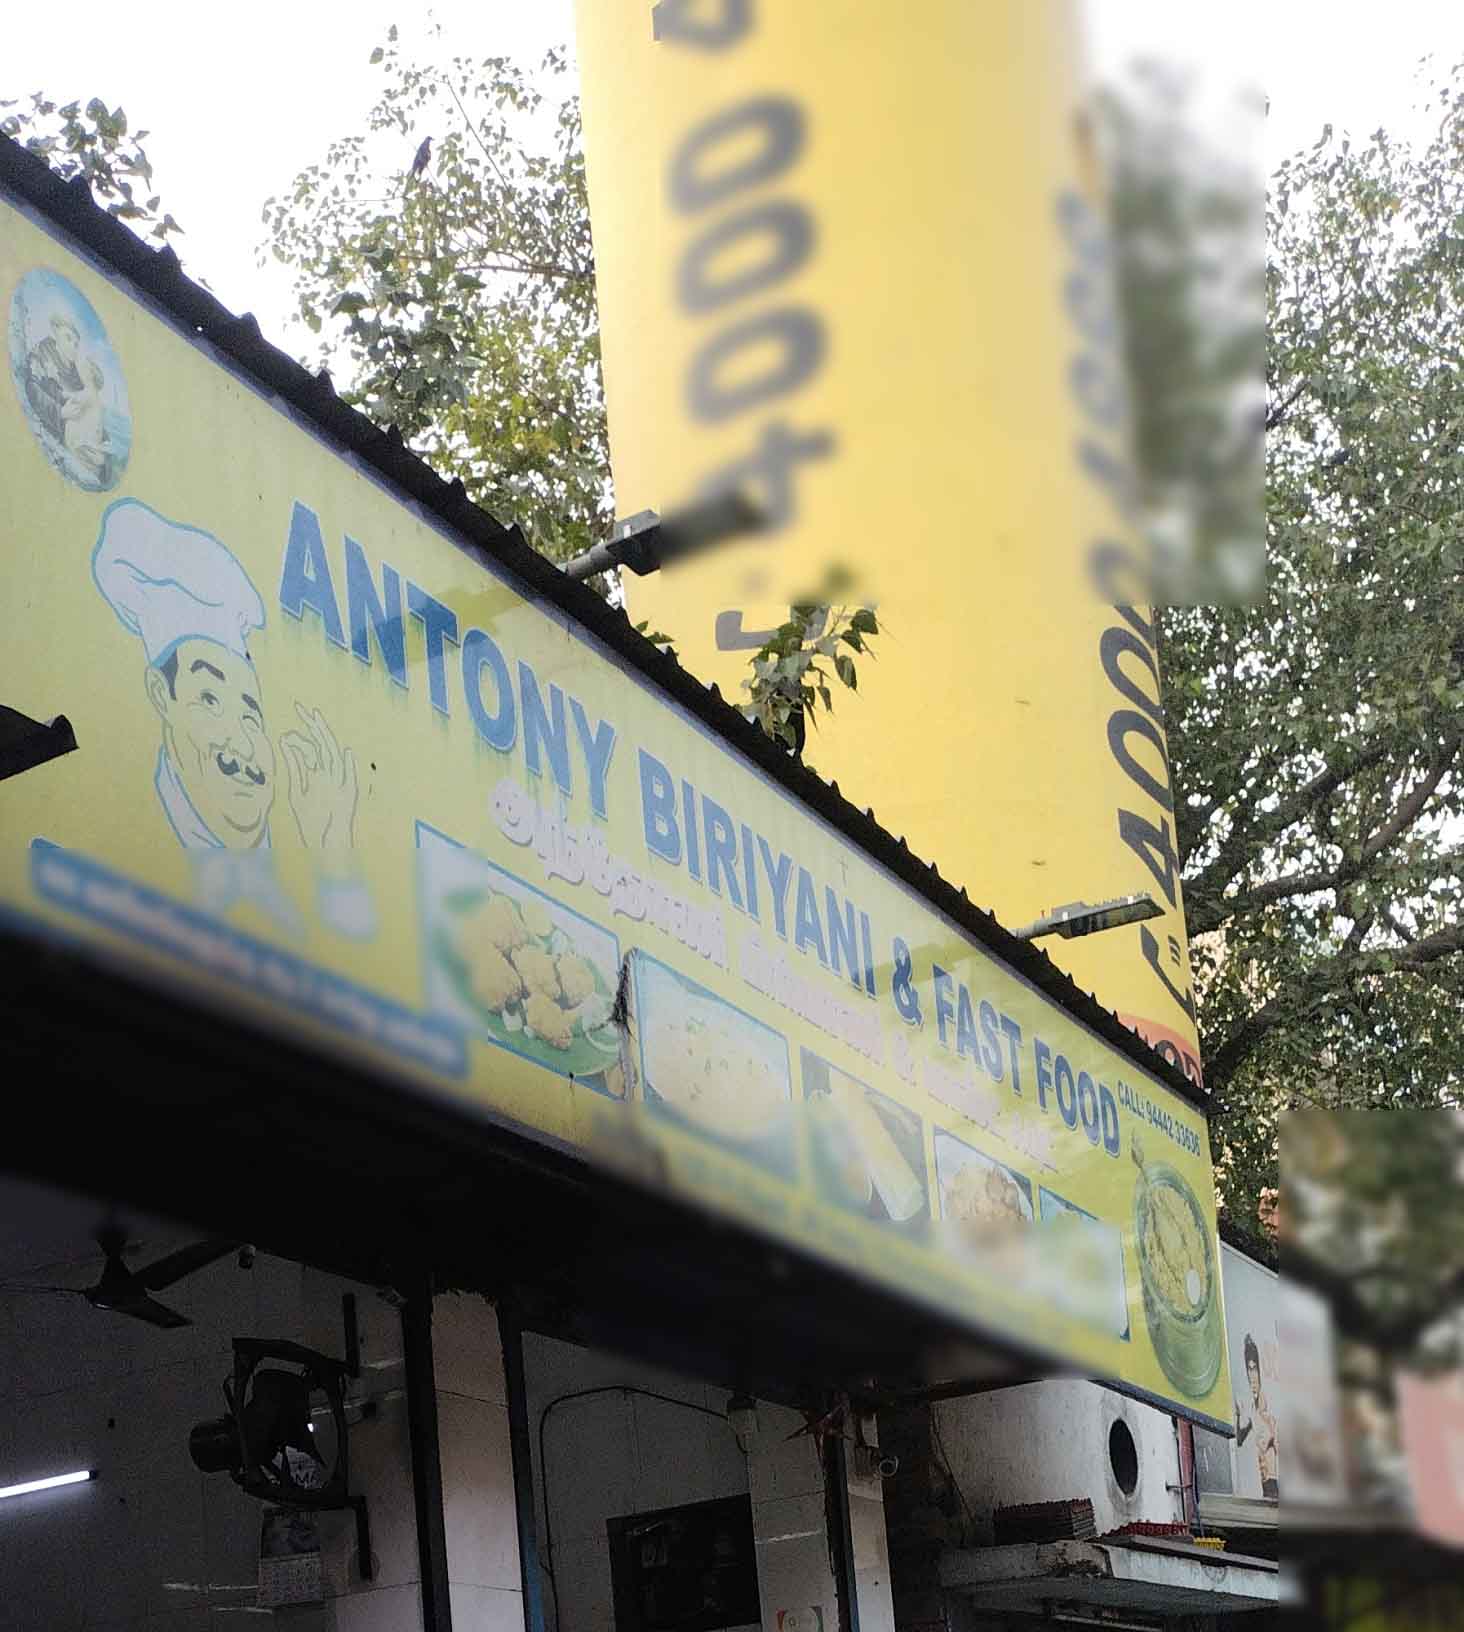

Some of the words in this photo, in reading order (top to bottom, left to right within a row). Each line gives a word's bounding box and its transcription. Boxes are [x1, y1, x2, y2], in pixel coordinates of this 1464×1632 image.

[279, 499, 617, 822] ANTONY
[637, 747, 879, 1000] BIRIYANI
[891, 936, 924, 1031] &
[932, 962, 1024, 1097] FAST
[1033, 1036, 1121, 1159] FOOD
